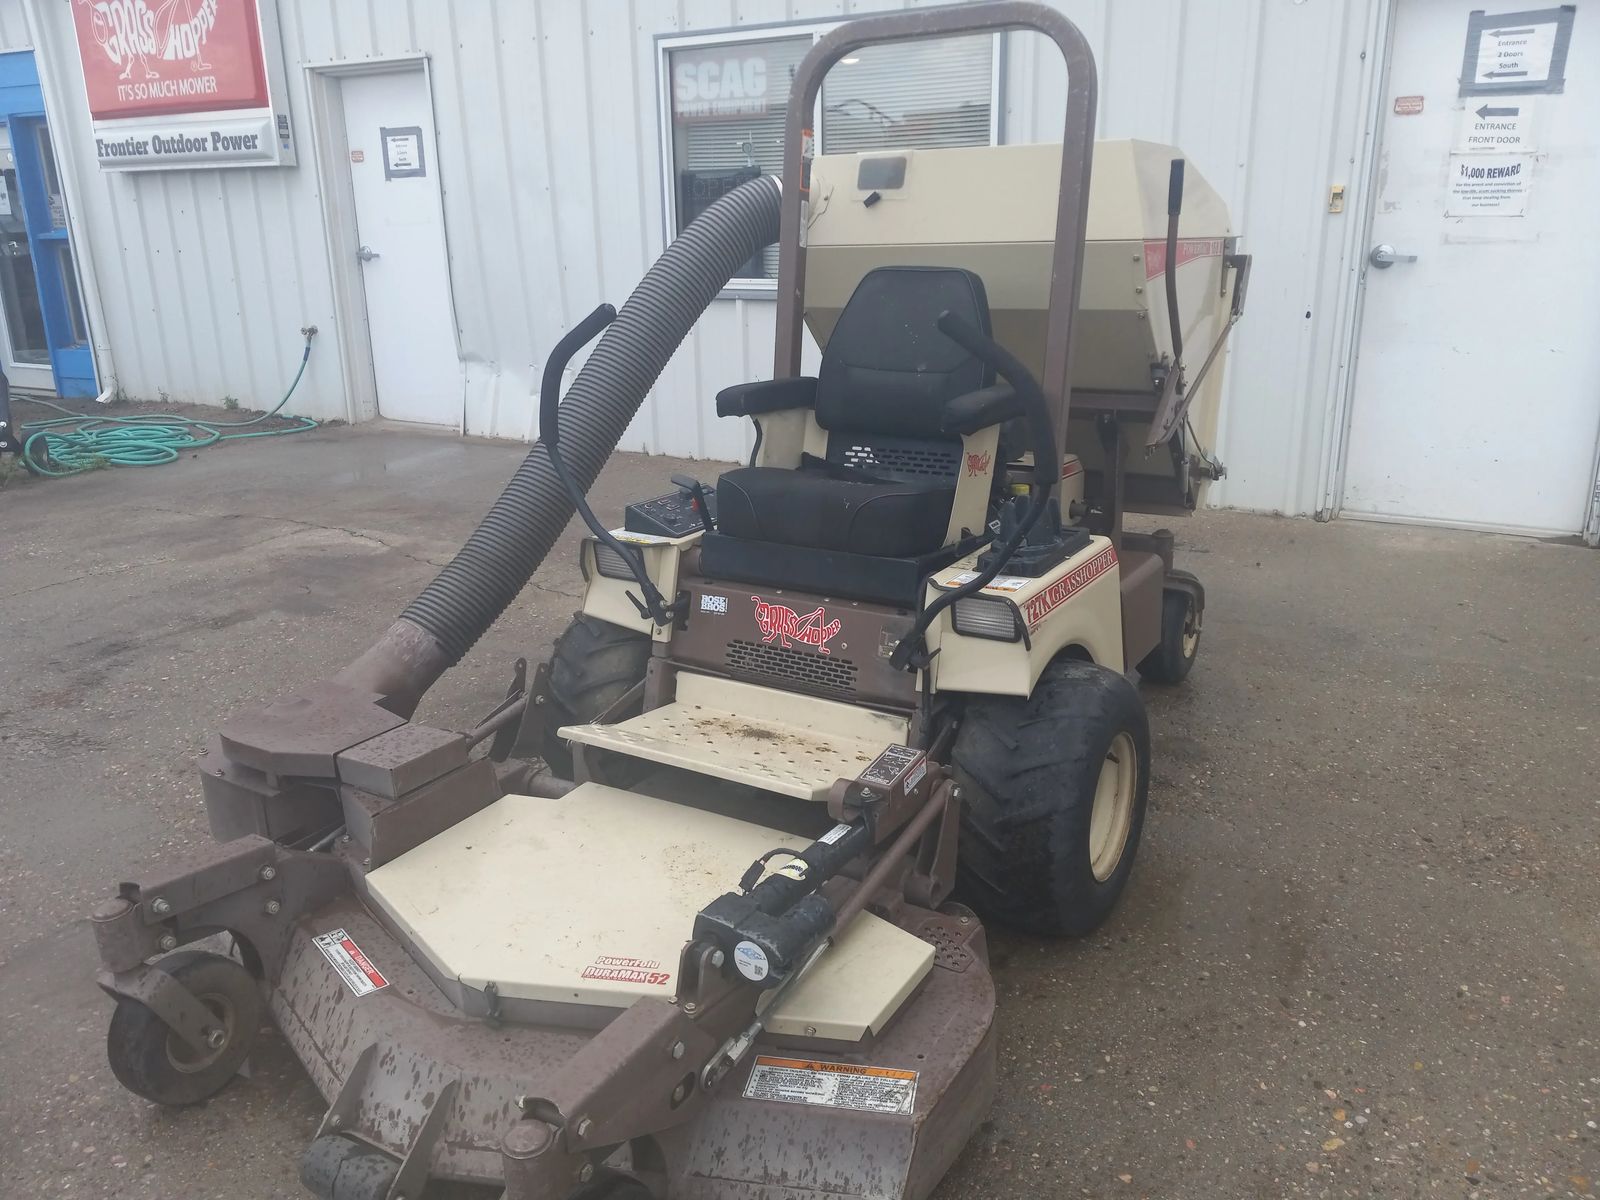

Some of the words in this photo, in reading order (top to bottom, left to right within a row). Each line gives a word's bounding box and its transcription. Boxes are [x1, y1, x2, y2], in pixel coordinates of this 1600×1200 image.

[675, 57, 767, 101] SCAG
[117, 84, 134, 101] IT'S
[134, 83, 148, 100] SO
[148, 79, 178, 98] MUCH
[178, 76, 217, 96] MOWER
[1474, 123, 1517, 131] ENTRANCE
[96, 137, 149, 158] Frontier
[152, 133, 208, 155] Outdoor
[210, 131, 258, 152] Power
[1468, 136, 1495, 144] FRONT
[1496, 136, 1521, 144] DOOR
[1461, 164, 1485, 180] $1,000
[1486, 163, 1521, 179] REWARD
[1052, 550, 1114, 603] GRASSHOPPER
[646, 972, 671, 985] 52
[819, 1063, 867, 1075] WARNING
